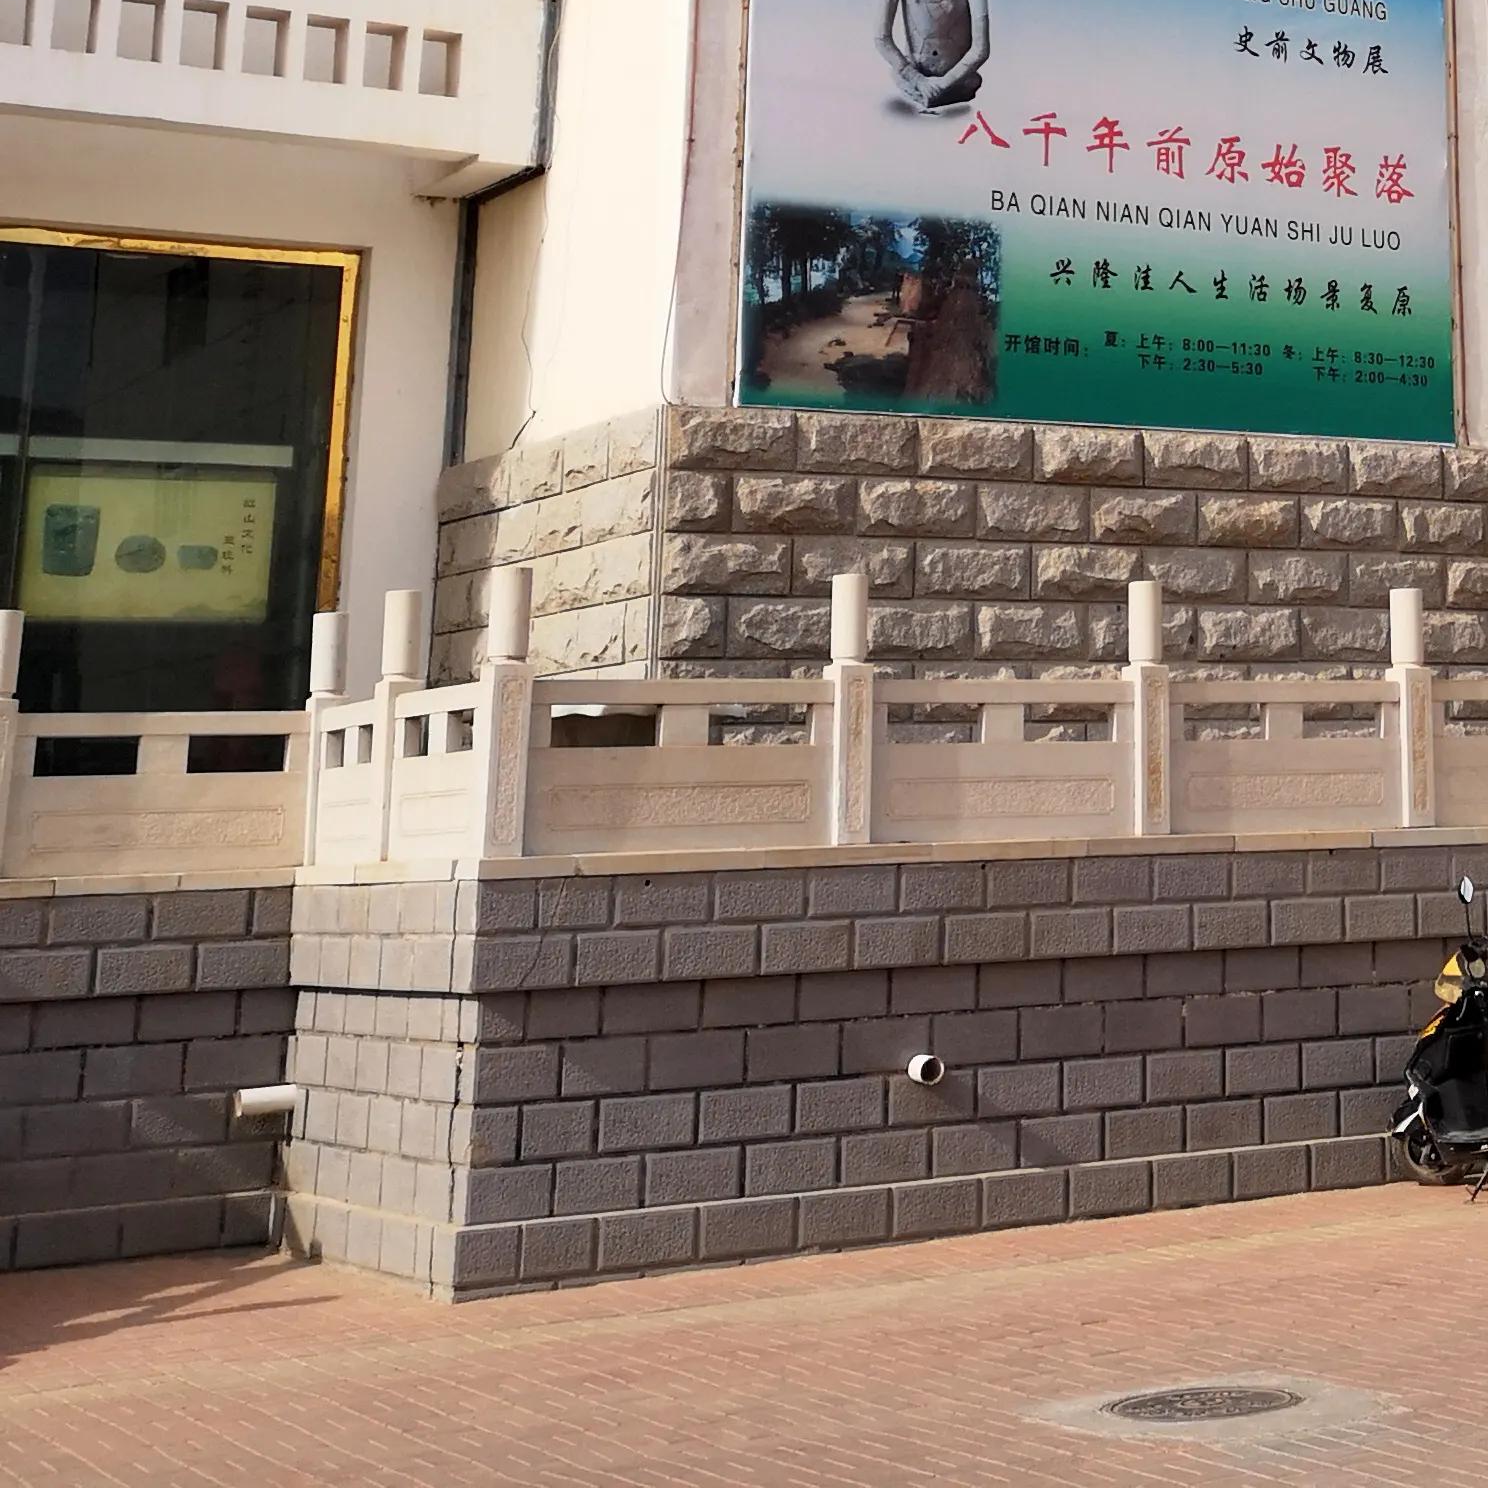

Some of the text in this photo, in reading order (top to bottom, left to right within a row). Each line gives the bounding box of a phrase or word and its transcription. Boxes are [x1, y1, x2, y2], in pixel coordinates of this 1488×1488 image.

[1234, 25, 1389, 75] 史前文物展
[959, 111, 1414, 204] 八千年前原始聚落
[991, 189, 1401, 251] BA QIAN NIAN QIAN YUAN SHI JU LUO
[1049, 257, 1412, 317] 兴隆洼人生活场景复原
